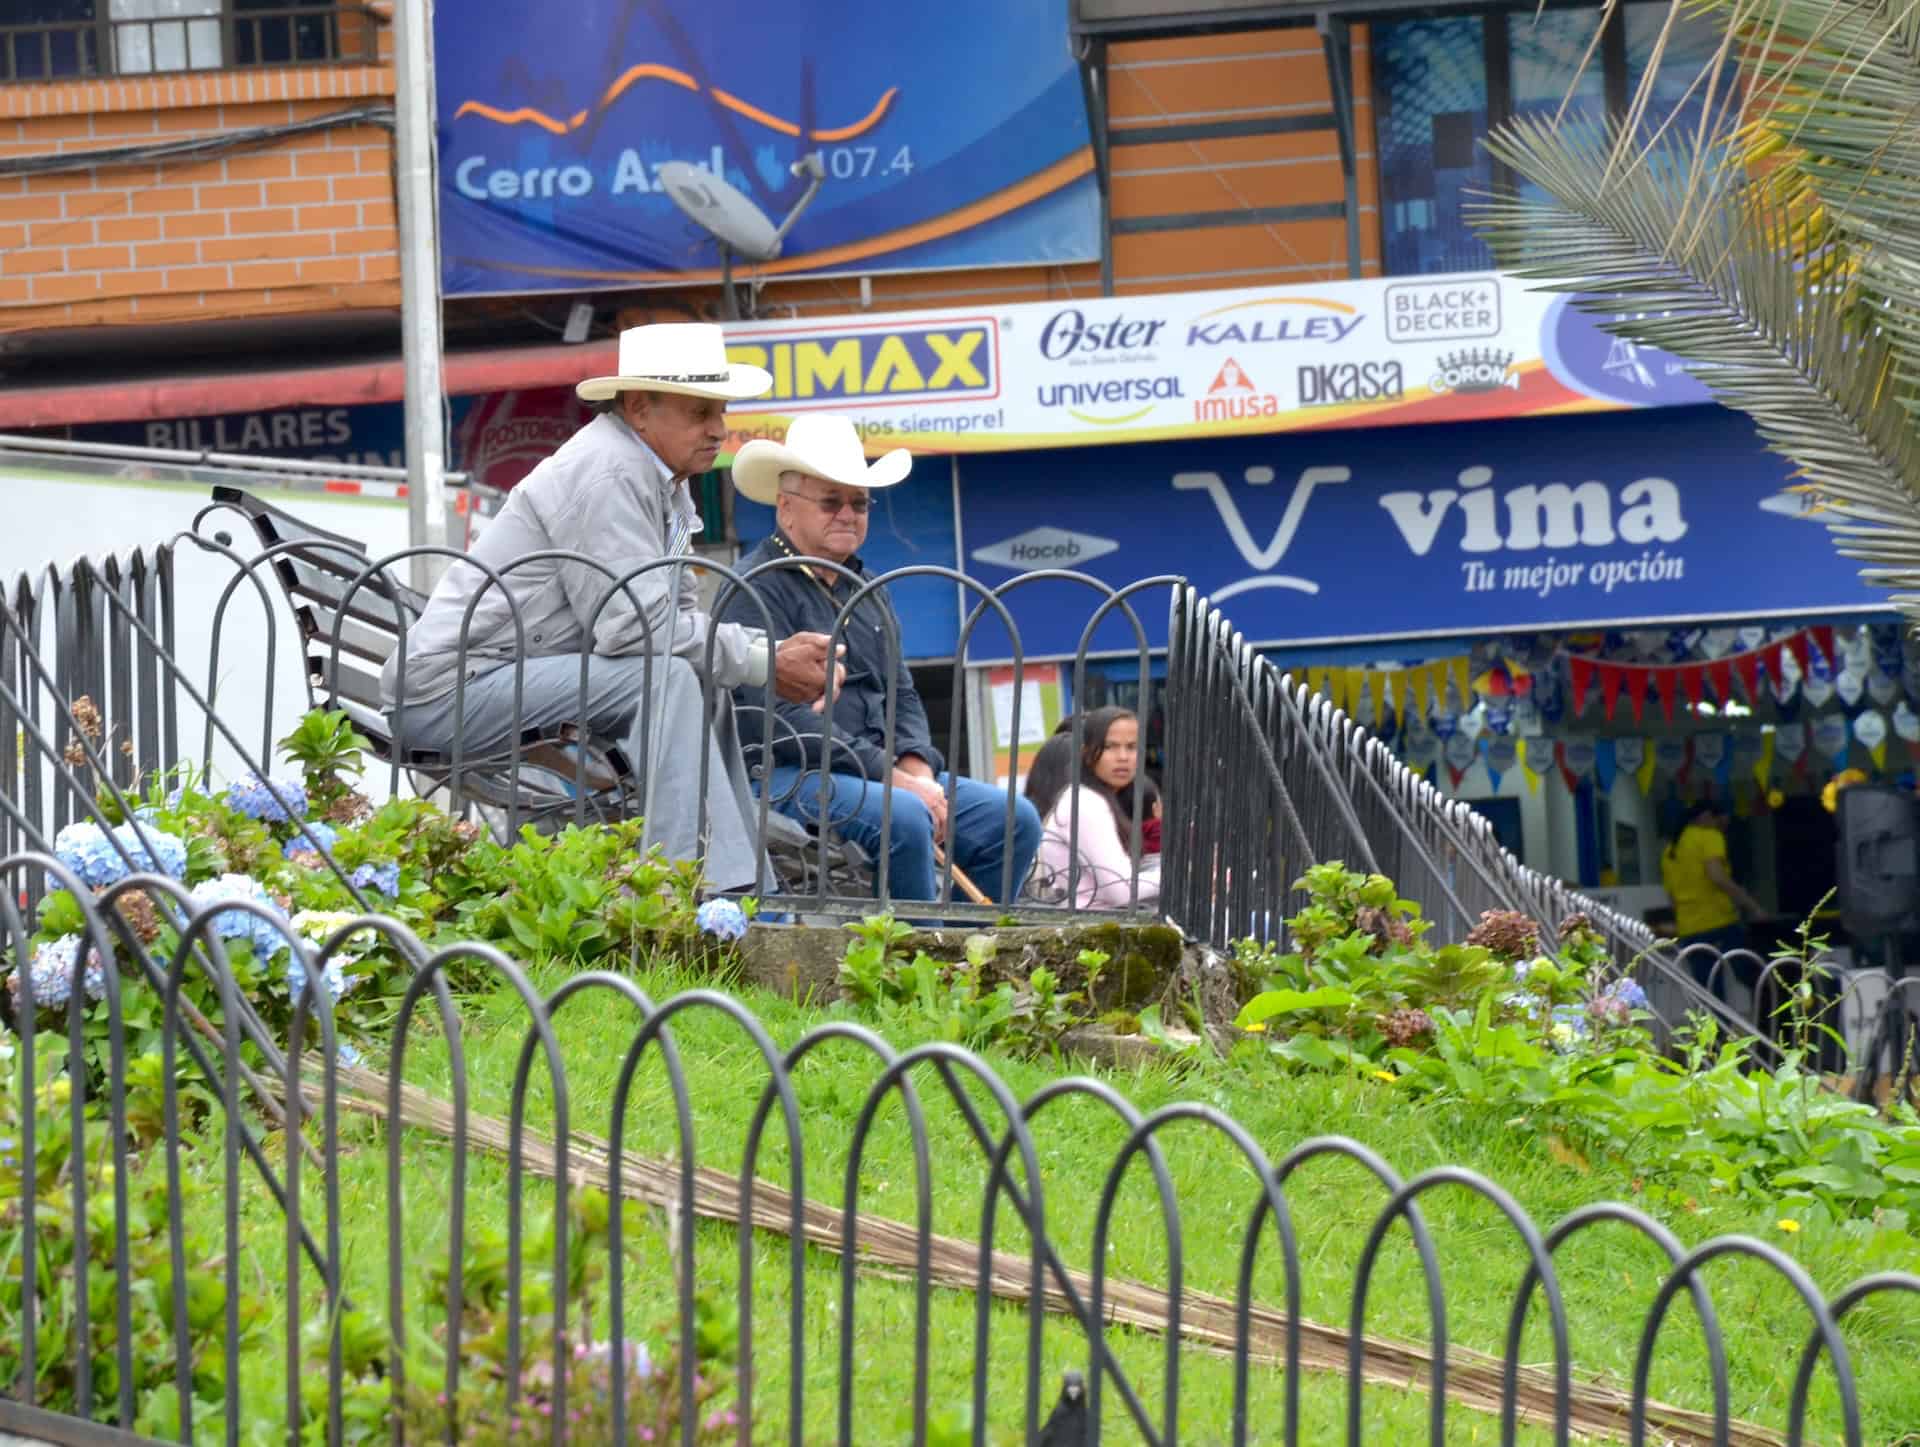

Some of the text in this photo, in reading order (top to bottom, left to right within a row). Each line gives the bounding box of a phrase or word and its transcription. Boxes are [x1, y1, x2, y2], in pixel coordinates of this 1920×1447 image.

[455, 156, 593, 200] Cerro
[1395, 289, 1489, 312] BLACK+
[1039, 309, 1166, 360] Oster
[1186, 314, 1366, 347] KALLEY
[1395, 310, 1492, 332] DECKER
[1038, 375, 1184, 407] universal
[1428, 363, 1521, 394] CORONA
[145, 409, 352, 450] BILLARES
[900, 409, 1004, 437] siempre!
[1379, 466, 1688, 556] vima
[1010, 538, 1080, 561] Haceb
[1461, 551, 1684, 597] Tu mejor opción
